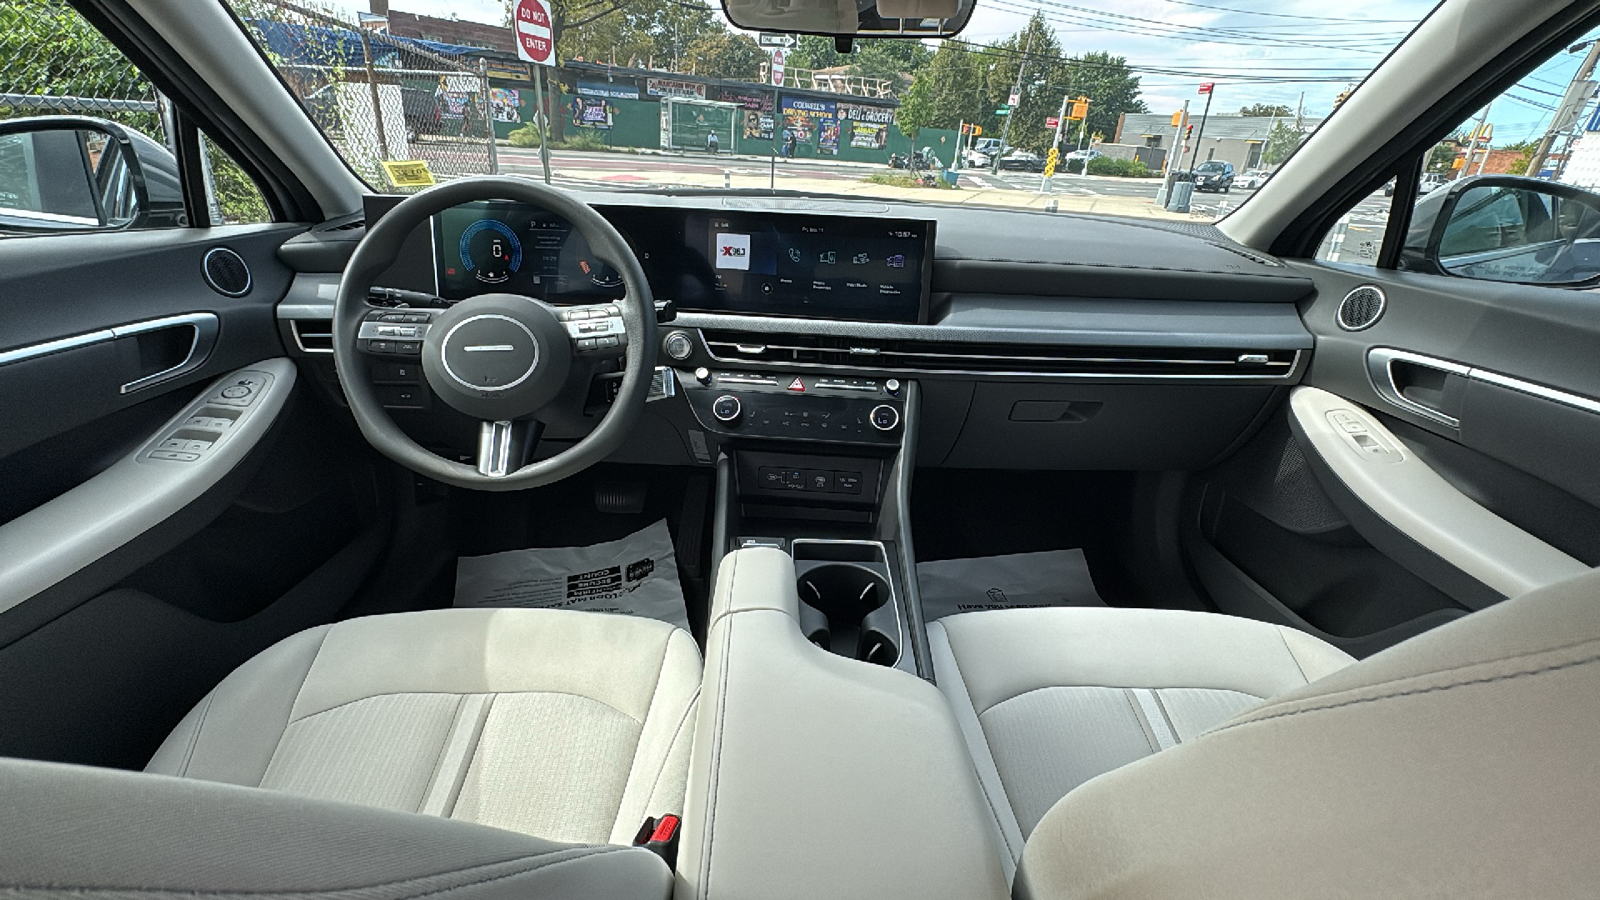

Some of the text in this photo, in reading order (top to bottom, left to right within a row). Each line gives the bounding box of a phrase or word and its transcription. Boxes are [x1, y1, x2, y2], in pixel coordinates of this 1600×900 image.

[521, 7, 545, 23] DO NOT
[525, 37, 548, 52] ENTER
[792, 101, 826, 111] COLWELL'S
[782, 107, 833, 119] DRIVING SCHOOL
[847, 109, 861, 120] DELI
[865, 111, 893, 124] GROCERY
[492, 244, 502, 258] 0
[579, 569, 610, 580] COUNT
[577, 578, 612, 588] SECURE
[566, 597, 588, 606] MAT
